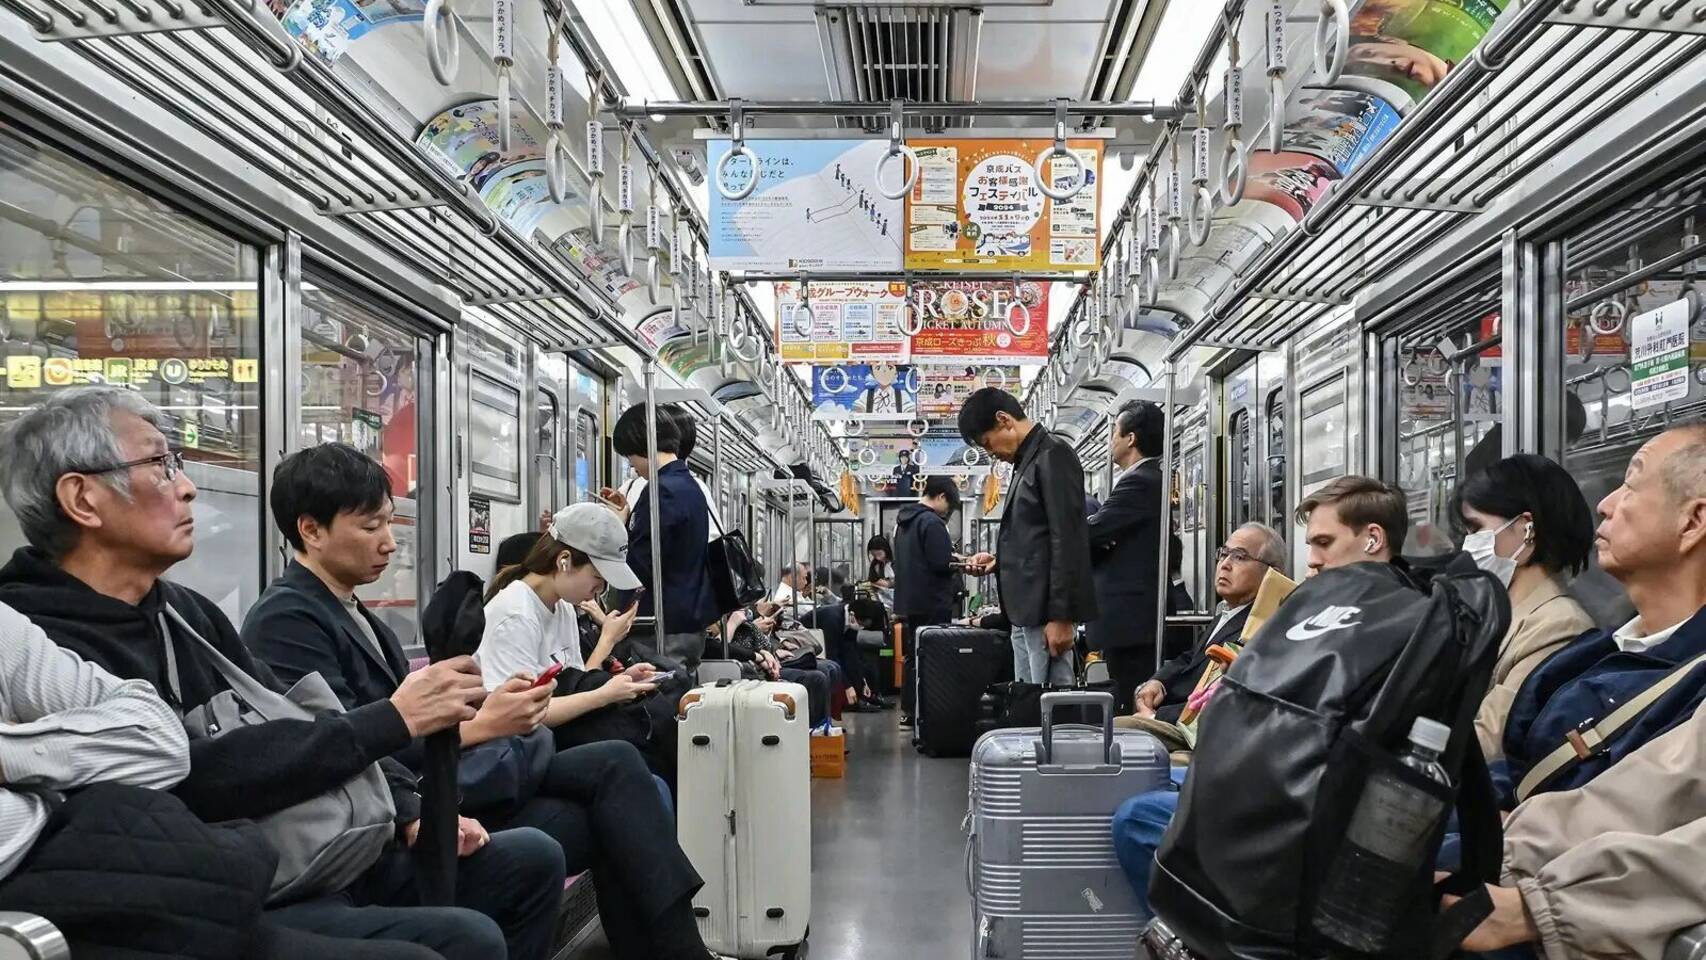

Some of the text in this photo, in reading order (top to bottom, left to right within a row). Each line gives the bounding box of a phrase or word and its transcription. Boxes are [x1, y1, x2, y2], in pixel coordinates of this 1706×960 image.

[968, 187, 1039, 202] フェスティバル
[922, 320, 957, 330] ICKET
[1307, 605, 1361, 627] NIKE
